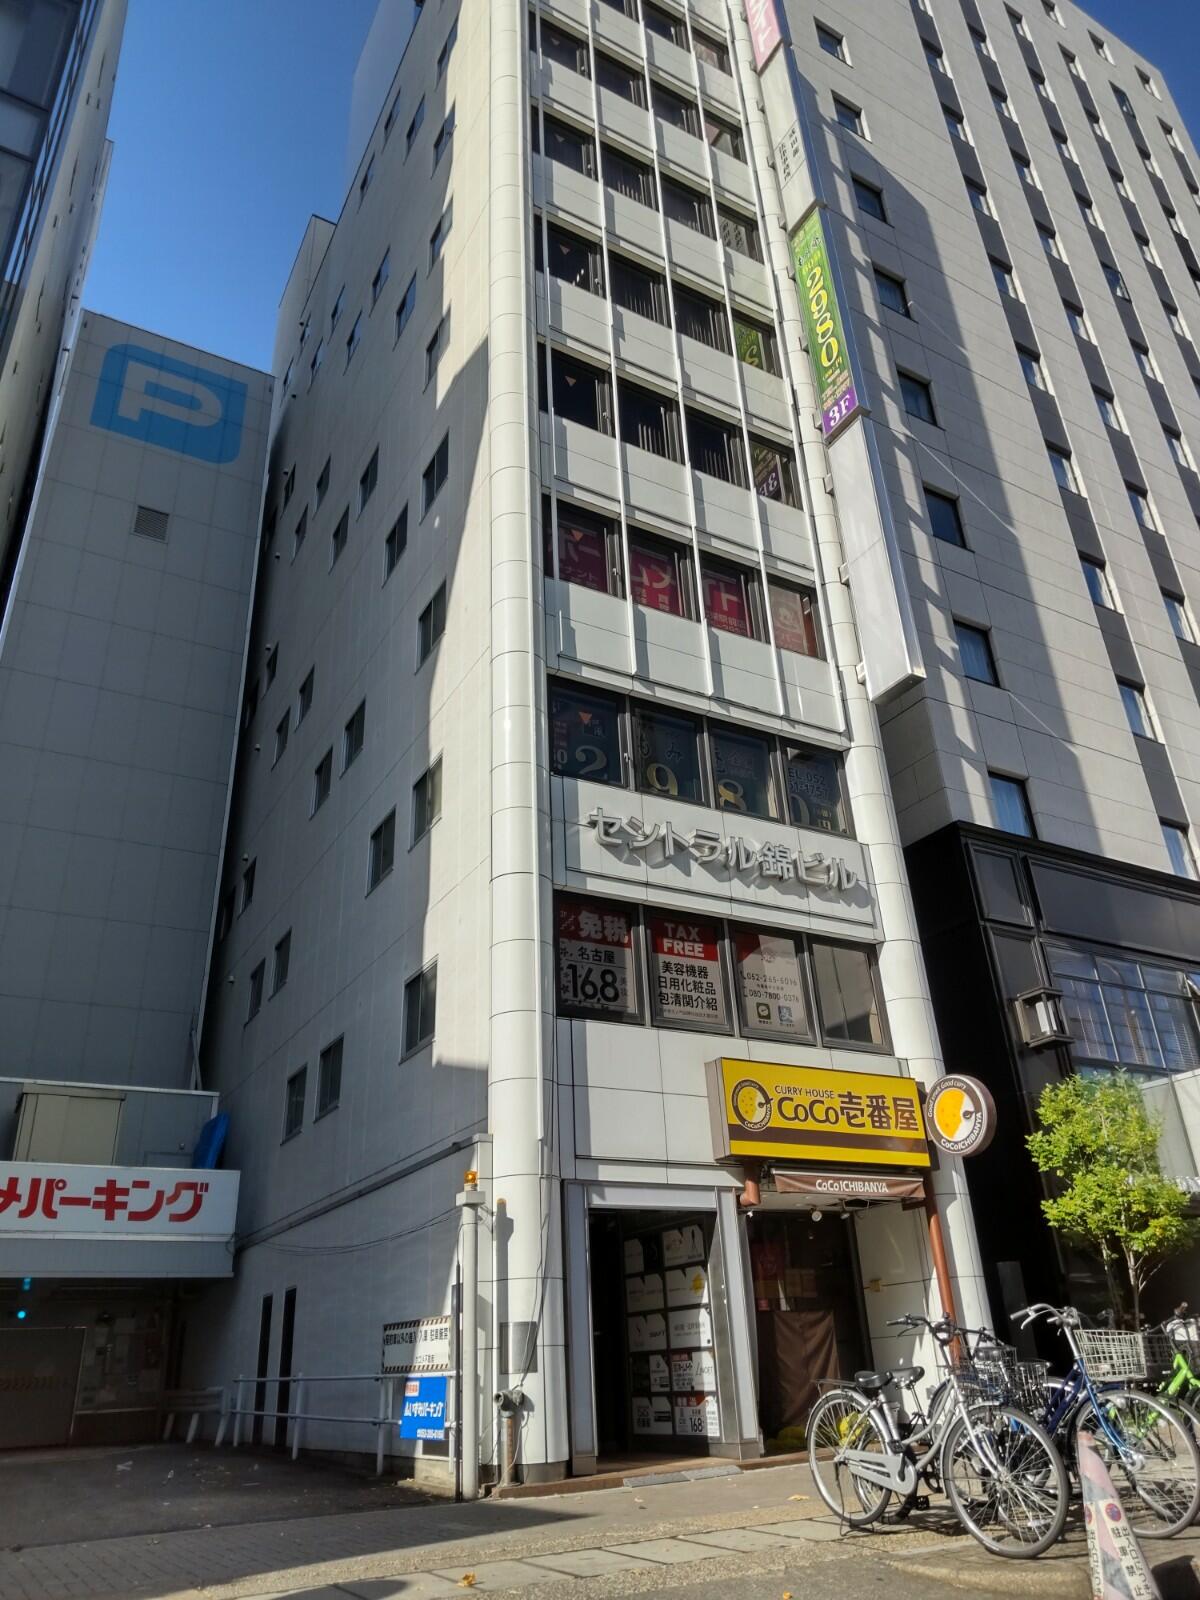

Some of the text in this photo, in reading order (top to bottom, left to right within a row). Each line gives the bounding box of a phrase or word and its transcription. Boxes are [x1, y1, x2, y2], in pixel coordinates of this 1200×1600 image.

[806, 266, 839, 369] 2980
[118, 361, 222, 428] P
[829, 394, 850, 427] 3F
[588, 807, 857, 891] セントラル錦ビル
[578, 910, 629, 944] 免税
[664, 923, 700, 941] TAX
[578, 947, 616, 965] 名古屋
[663, 938, 704, 958] FREE
[567, 963, 620, 1003] 168
[658, 976, 717, 995] 日用化粧品
[662, 961, 709, 979] 美容機器
[775, 1085, 835, 1099] CURRY HOUSE
[777, 1091, 919, 1132] CoCo壱番屋
